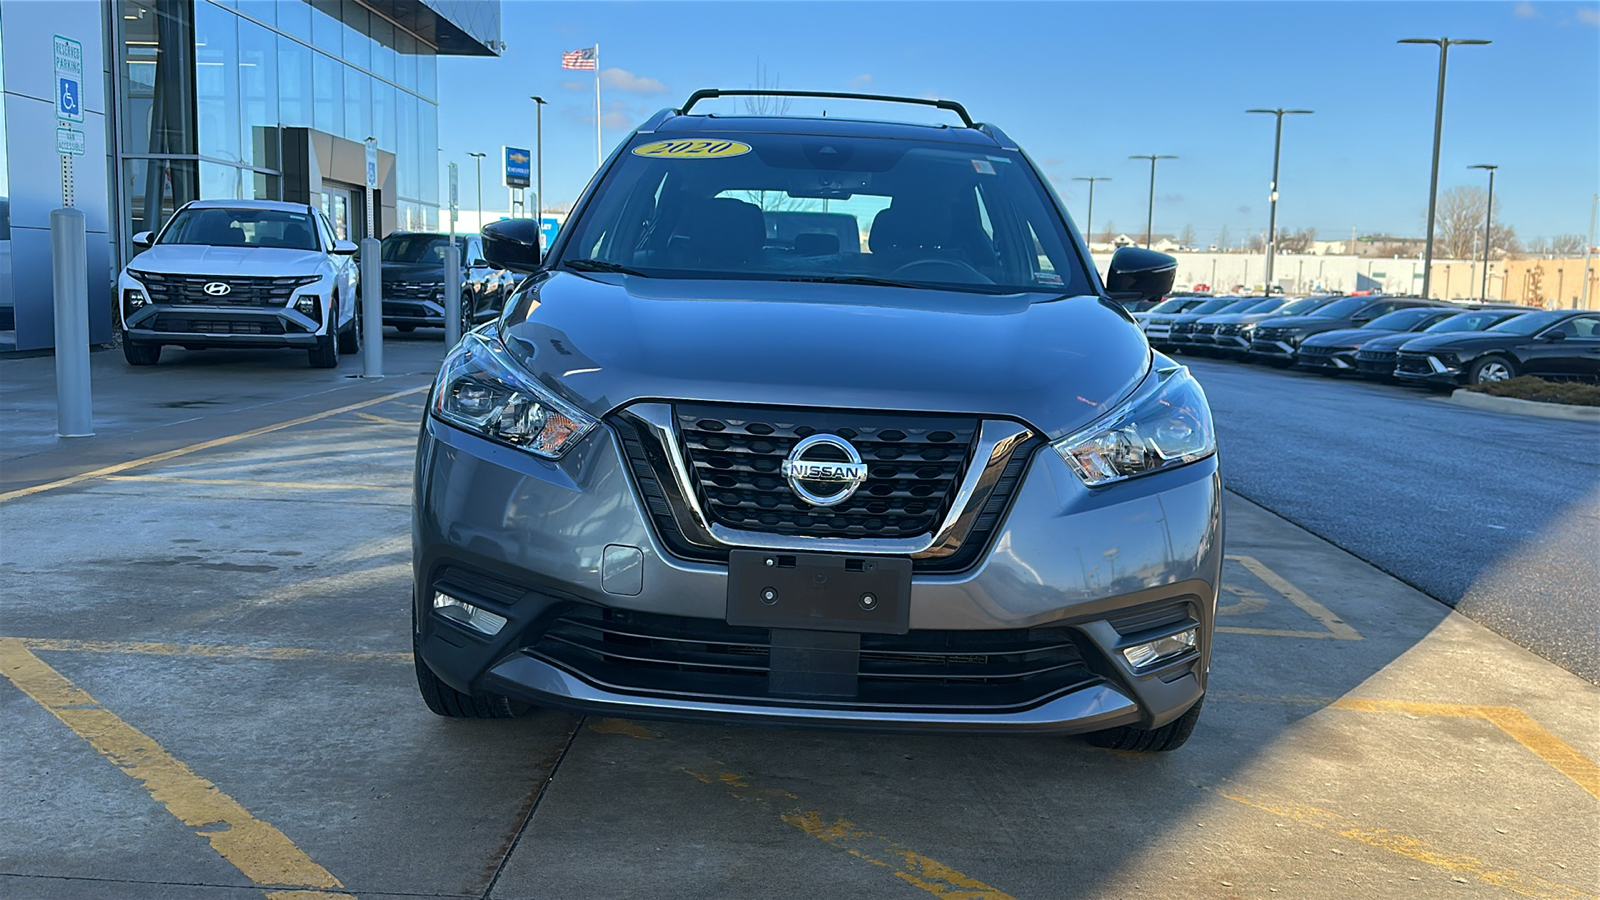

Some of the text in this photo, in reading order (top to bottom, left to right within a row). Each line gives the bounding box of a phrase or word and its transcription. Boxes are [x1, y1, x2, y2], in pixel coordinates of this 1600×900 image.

[56, 42, 79, 59] RESERVED
[57, 57, 80, 73] PARKING
[59, 142, 83, 151] ACCESSIBLE
[646, 142, 733, 154] 2020
[790, 464, 858, 478] NISSAN
